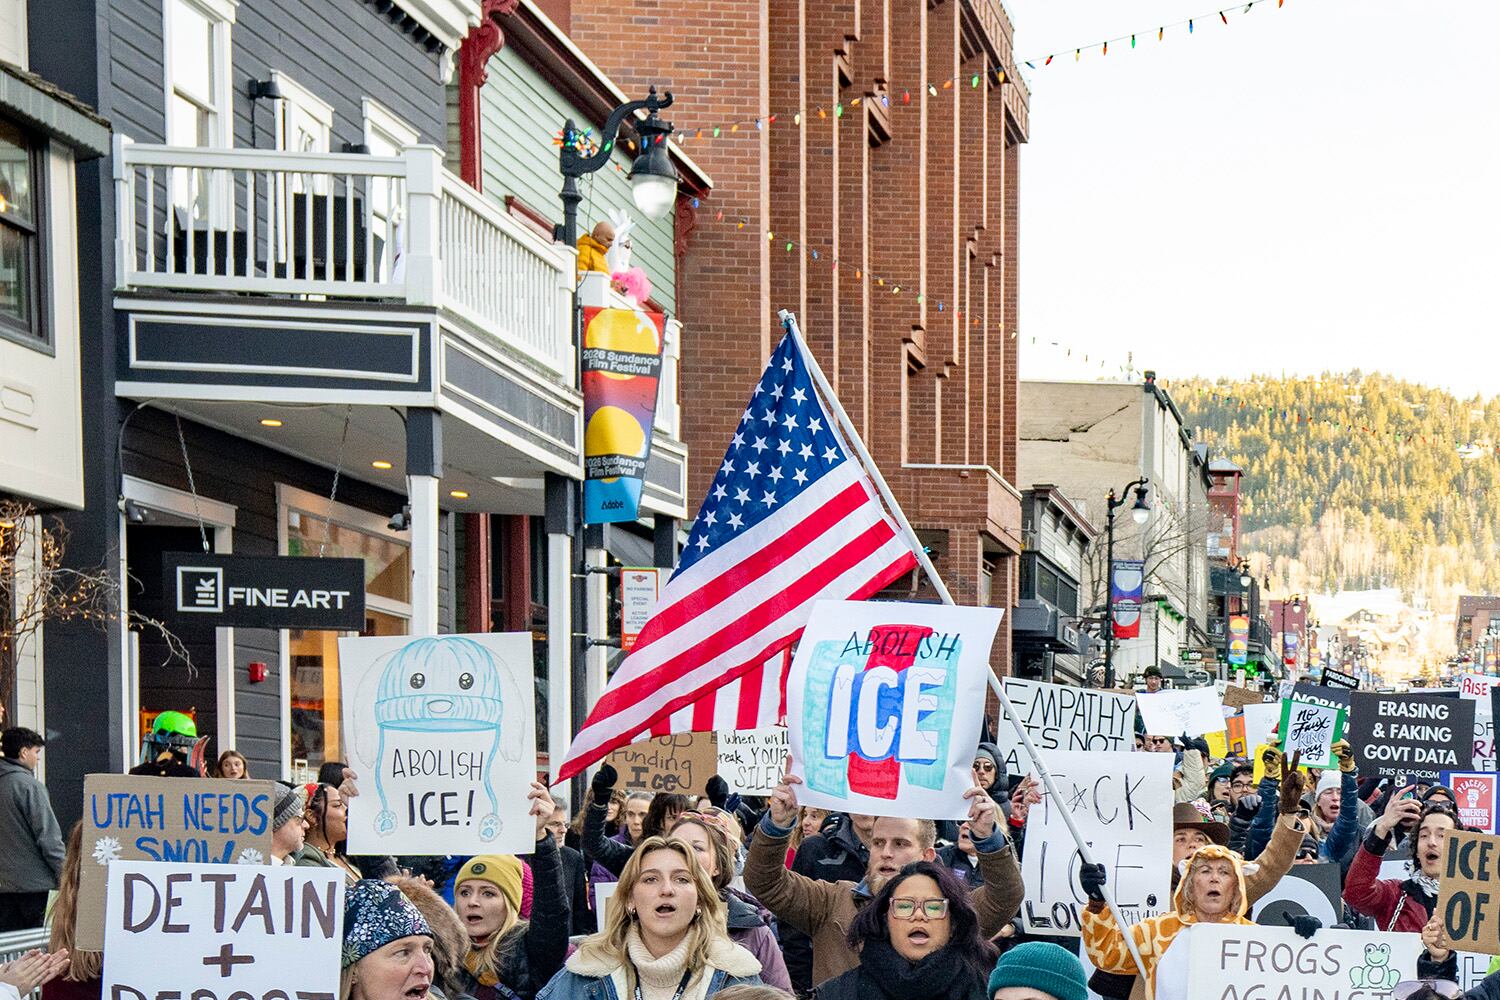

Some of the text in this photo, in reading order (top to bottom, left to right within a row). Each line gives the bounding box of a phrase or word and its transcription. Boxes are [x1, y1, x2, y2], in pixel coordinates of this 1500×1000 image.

[583, 350, 659, 366] 2026 Sundance
[588, 358, 650, 374] Film Festival
[601, 500, 624, 510] Adobe
[228, 587, 289, 608] FINE
[291, 590, 350, 610] ART
[840, 631, 960, 661] ABOLISH
[1462, 678, 1488, 696] RISE
[825, 664, 947, 763] ICE
[1003, 682, 1135, 736] EMPATHY
[1378, 701, 1449, 720] ERASING
[765, 731, 789, 745] will
[1018, 724, 1125, 751] IS NOT
[1373, 722, 1452, 742] & FAKING
[392, 748, 484, 781] ABOLISH
[718, 747, 789, 765] reak YOUR
[1363, 744, 1458, 765] GOVT DATA
[1379, 767, 1395, 775] THIS
[1405, 768, 1440, 779] FASCISM
[1457, 779, 1490, 796] PEACEFUL
[92, 793, 269, 836] UTAH NEEDS
[408, 790, 475, 826] ICE!
[1457, 808, 1489, 818] POWERFUL
[135, 837, 235, 864] SNOW
[1446, 837, 1494, 882] ICE
[122, 873, 338, 940] DETAIN
[1445, 891, 1490, 942] OF
[1220, 939, 1343, 976] FROGS
